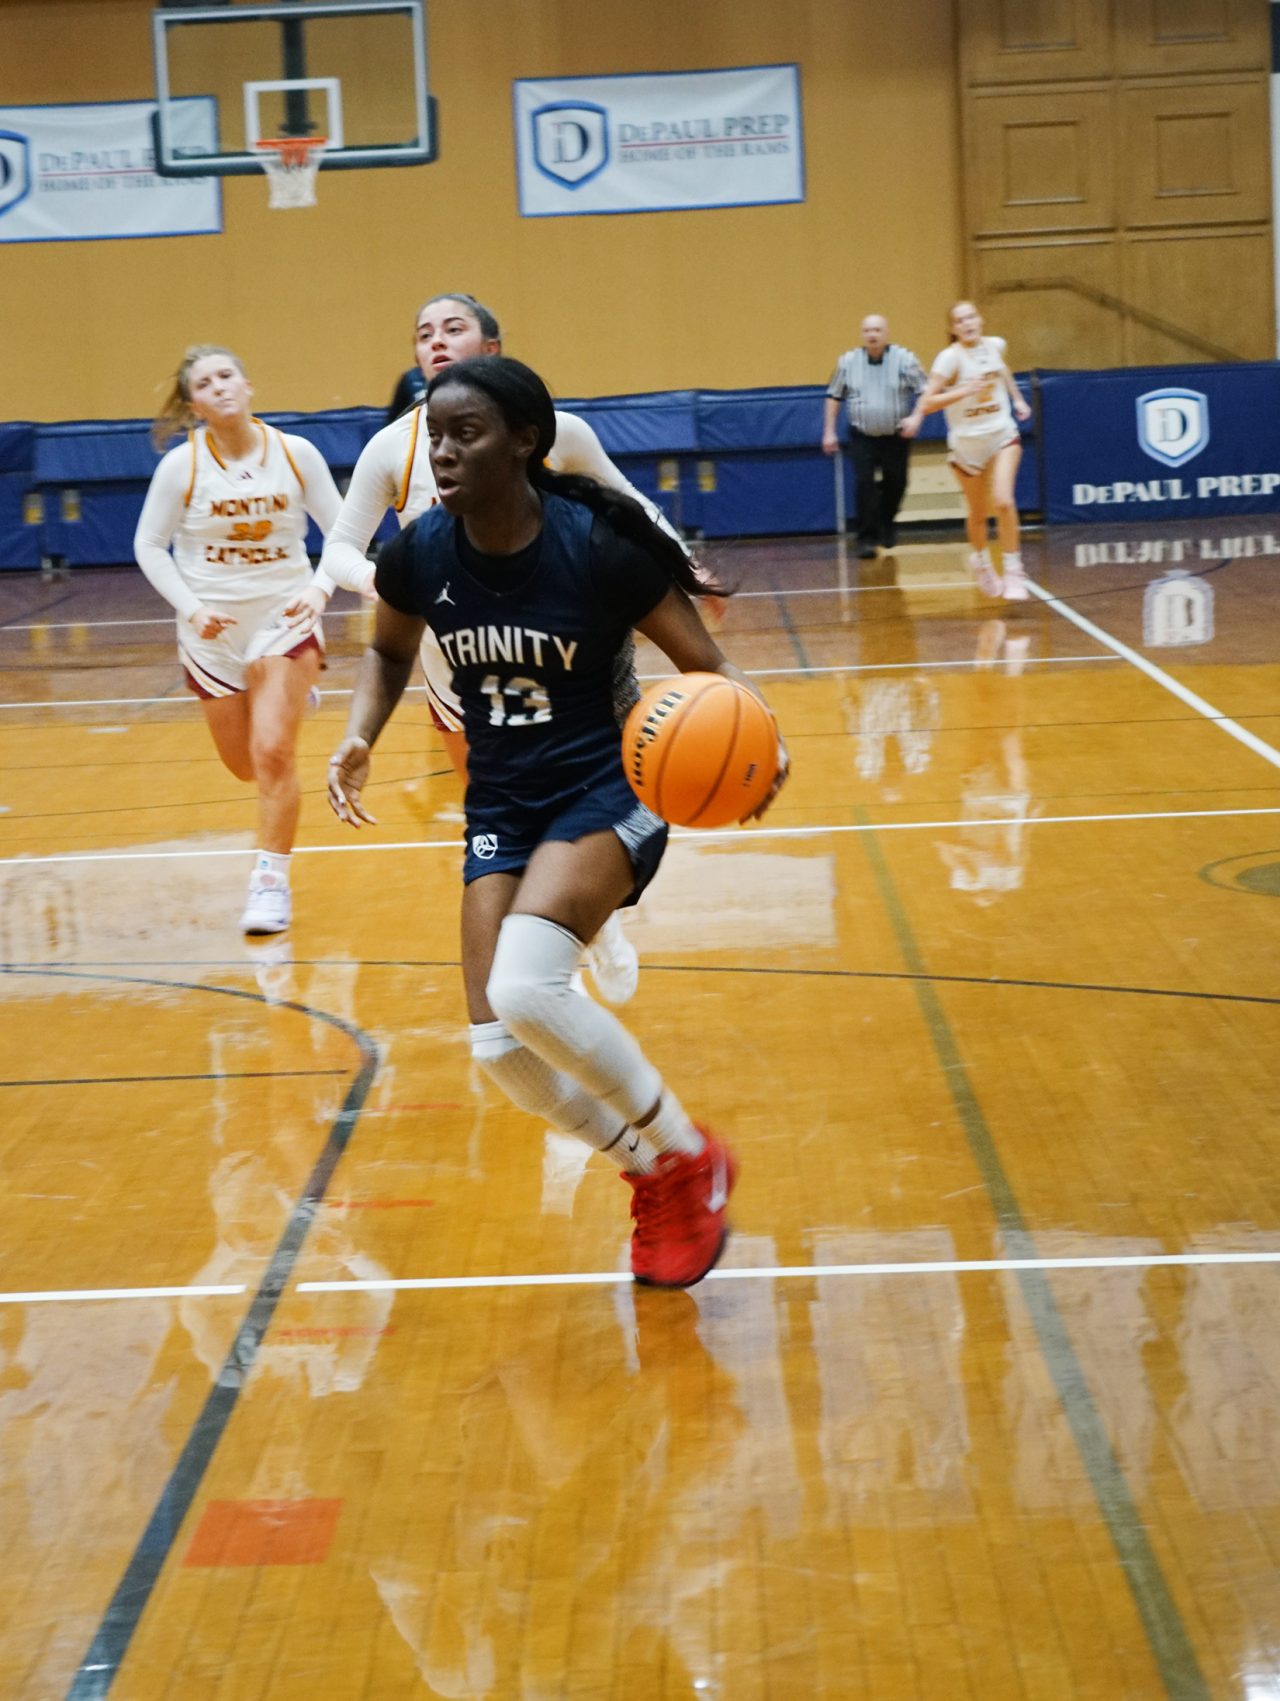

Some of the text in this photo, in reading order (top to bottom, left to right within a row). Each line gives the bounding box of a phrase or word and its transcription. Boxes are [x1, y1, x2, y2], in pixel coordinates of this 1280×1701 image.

[552, 121, 590, 163] D
[723, 114, 790, 138] PREP
[1157, 408, 1187, 442] D
[1197, 473, 1280, 498] PREP
[440, 625, 577, 671] TRINITY
[480, 674, 552, 727] 13
